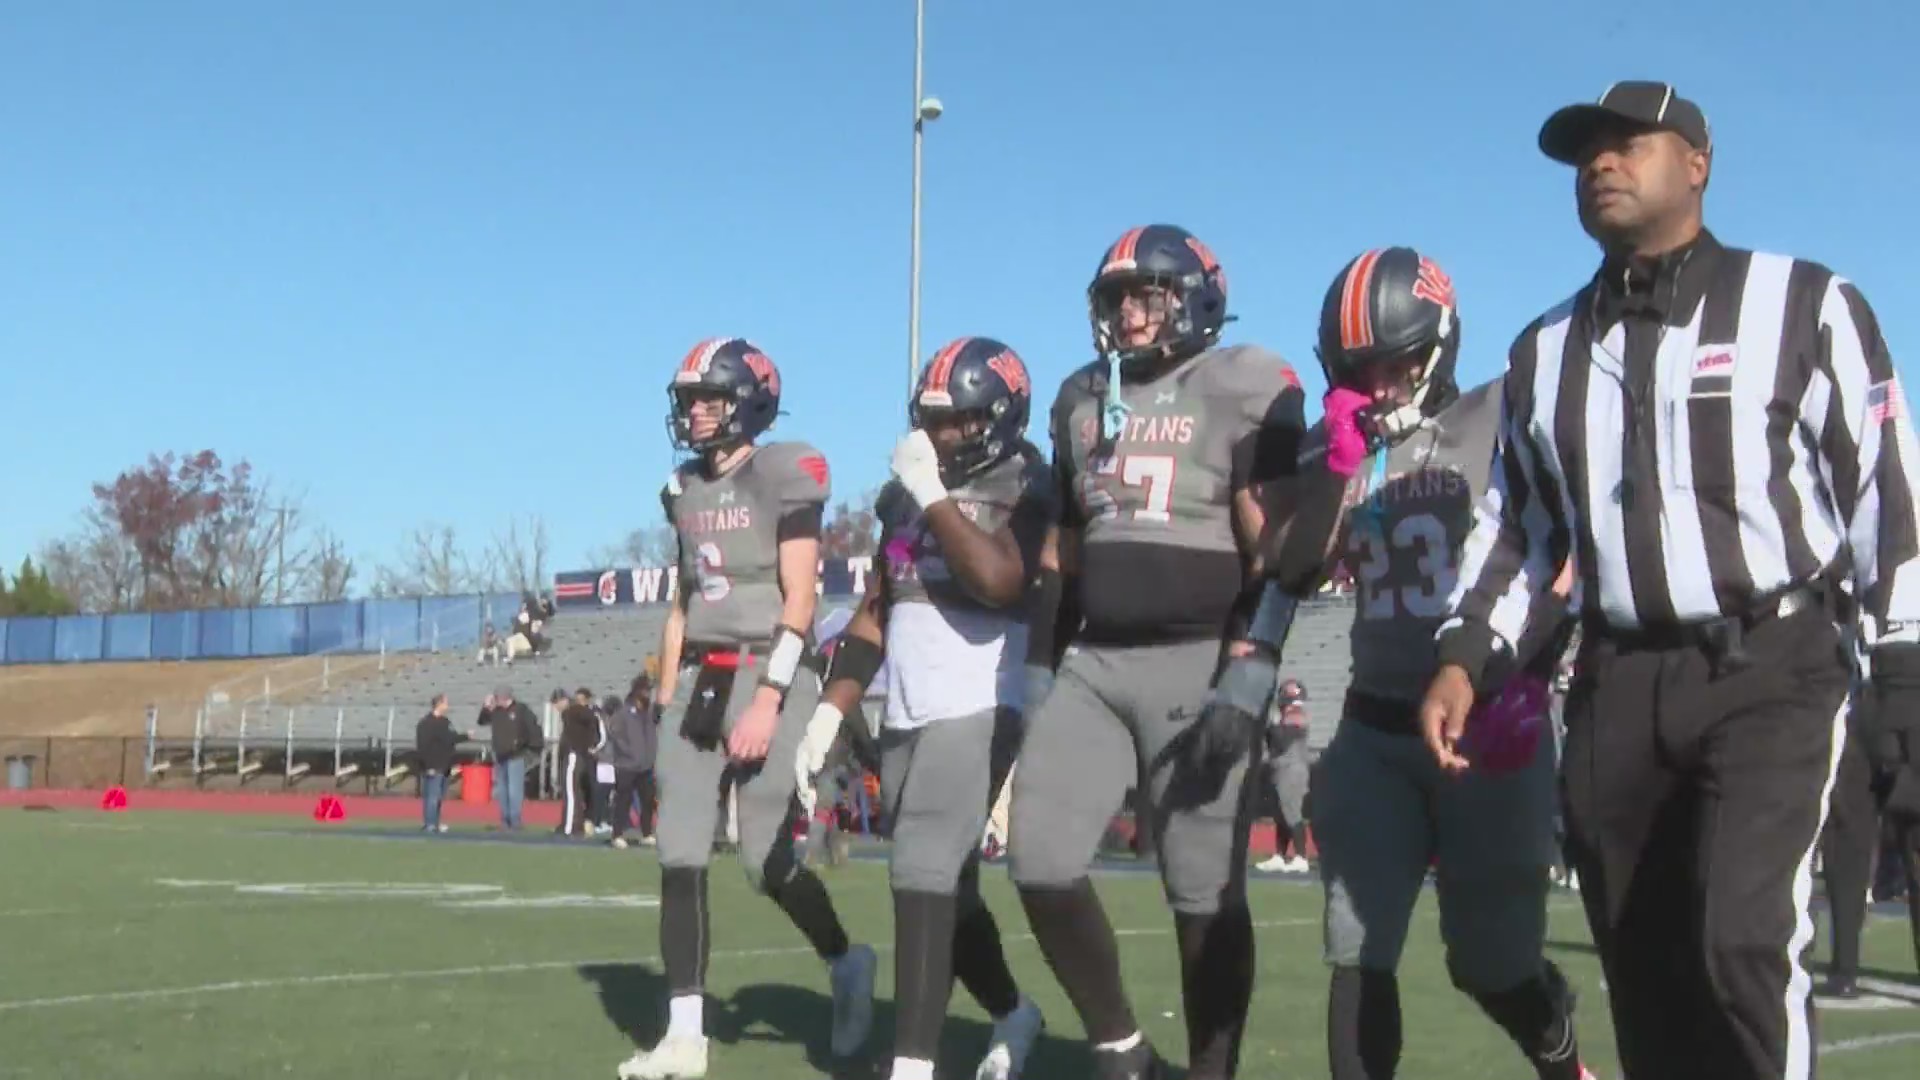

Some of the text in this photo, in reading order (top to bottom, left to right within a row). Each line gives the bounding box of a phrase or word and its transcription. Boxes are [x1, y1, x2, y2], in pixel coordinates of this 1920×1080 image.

[1080, 414, 1194, 444] STANS
[678, 506, 751, 533] TANS
[694, 541, 733, 603] 6
[1348, 512, 1456, 619] 23
